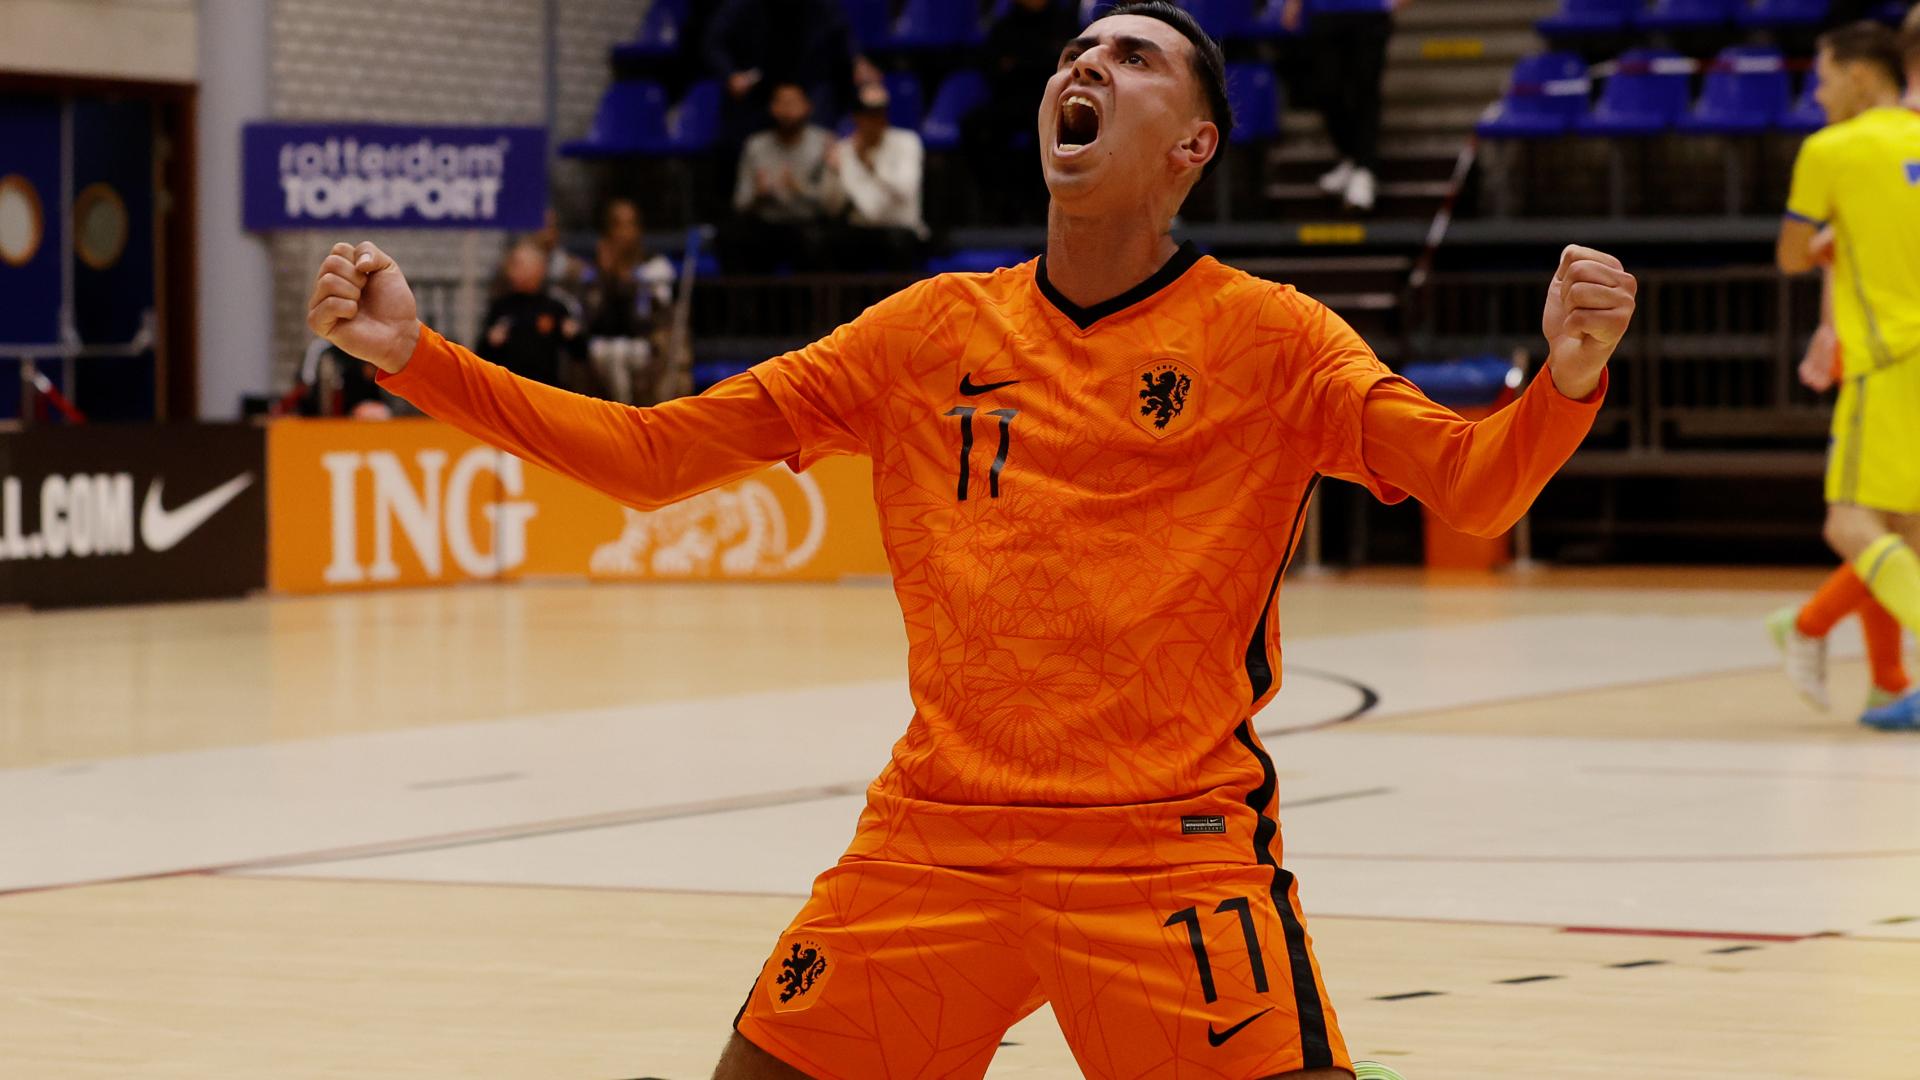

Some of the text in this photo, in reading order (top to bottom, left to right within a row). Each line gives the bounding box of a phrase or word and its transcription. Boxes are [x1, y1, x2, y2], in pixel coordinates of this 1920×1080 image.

[282, 176, 501, 219] TOPSPORT
[0, 472, 135, 560] L.COM
[322, 446, 538, 582] ING
[1163, 896, 1269, 1004] 11
